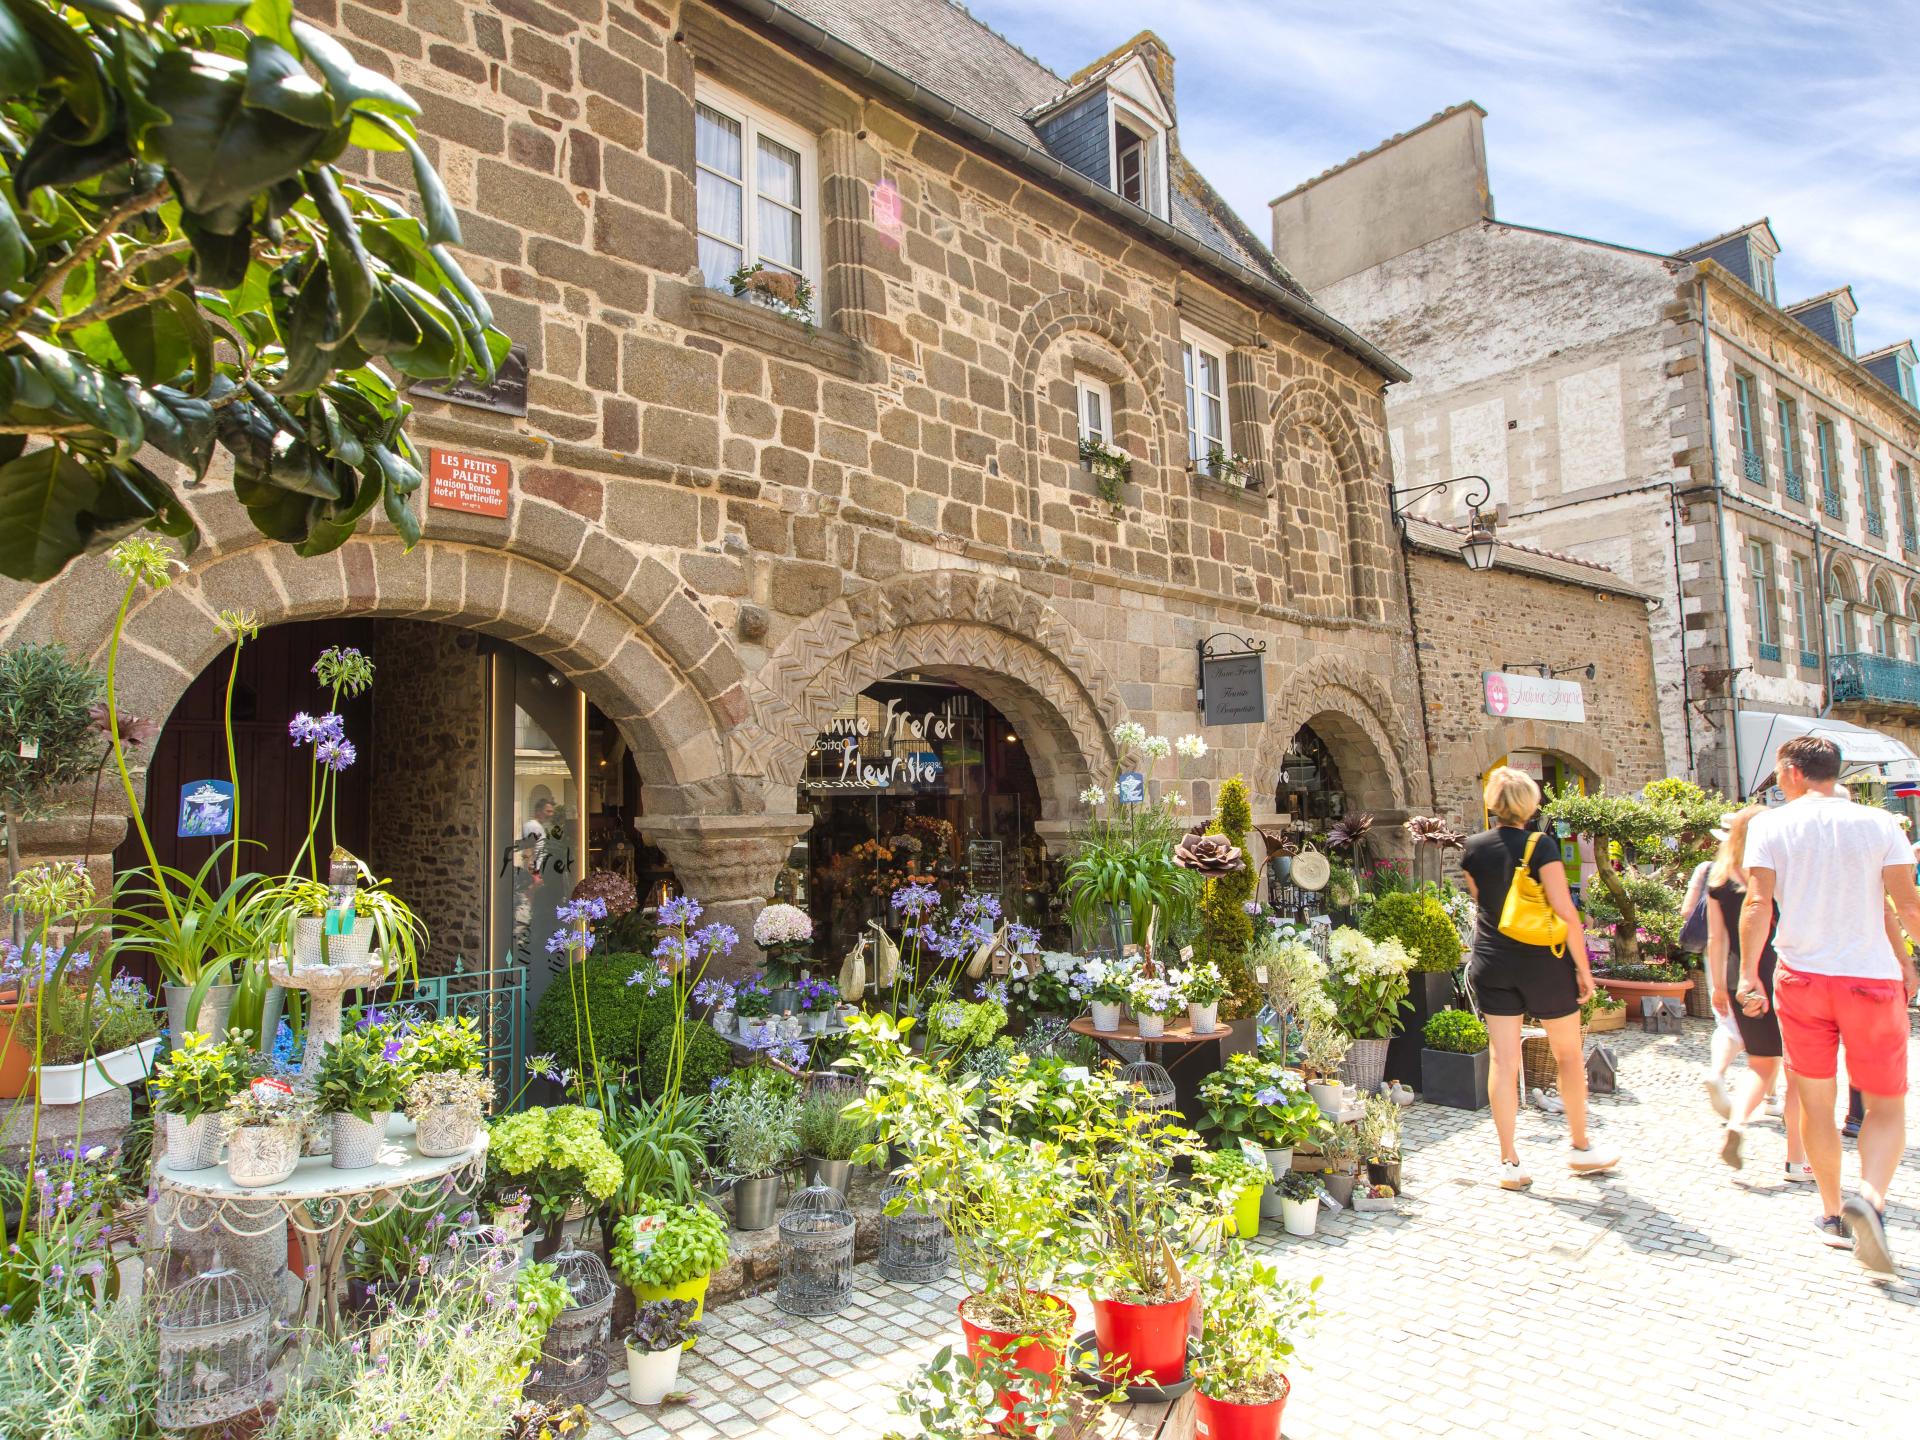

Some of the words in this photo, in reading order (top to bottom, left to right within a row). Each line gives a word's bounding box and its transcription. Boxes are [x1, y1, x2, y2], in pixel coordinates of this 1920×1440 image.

[441, 454, 459, 467] LES
[463, 458, 498, 474] PETITS
[452, 469, 492, 485] PALETS
[435, 478, 467, 490] Maison
[468, 482, 501, 496] Romane
[460, 490, 503, 505] Particulier
[824, 716, 870, 737] nne
[884, 698, 956, 739] Freret
